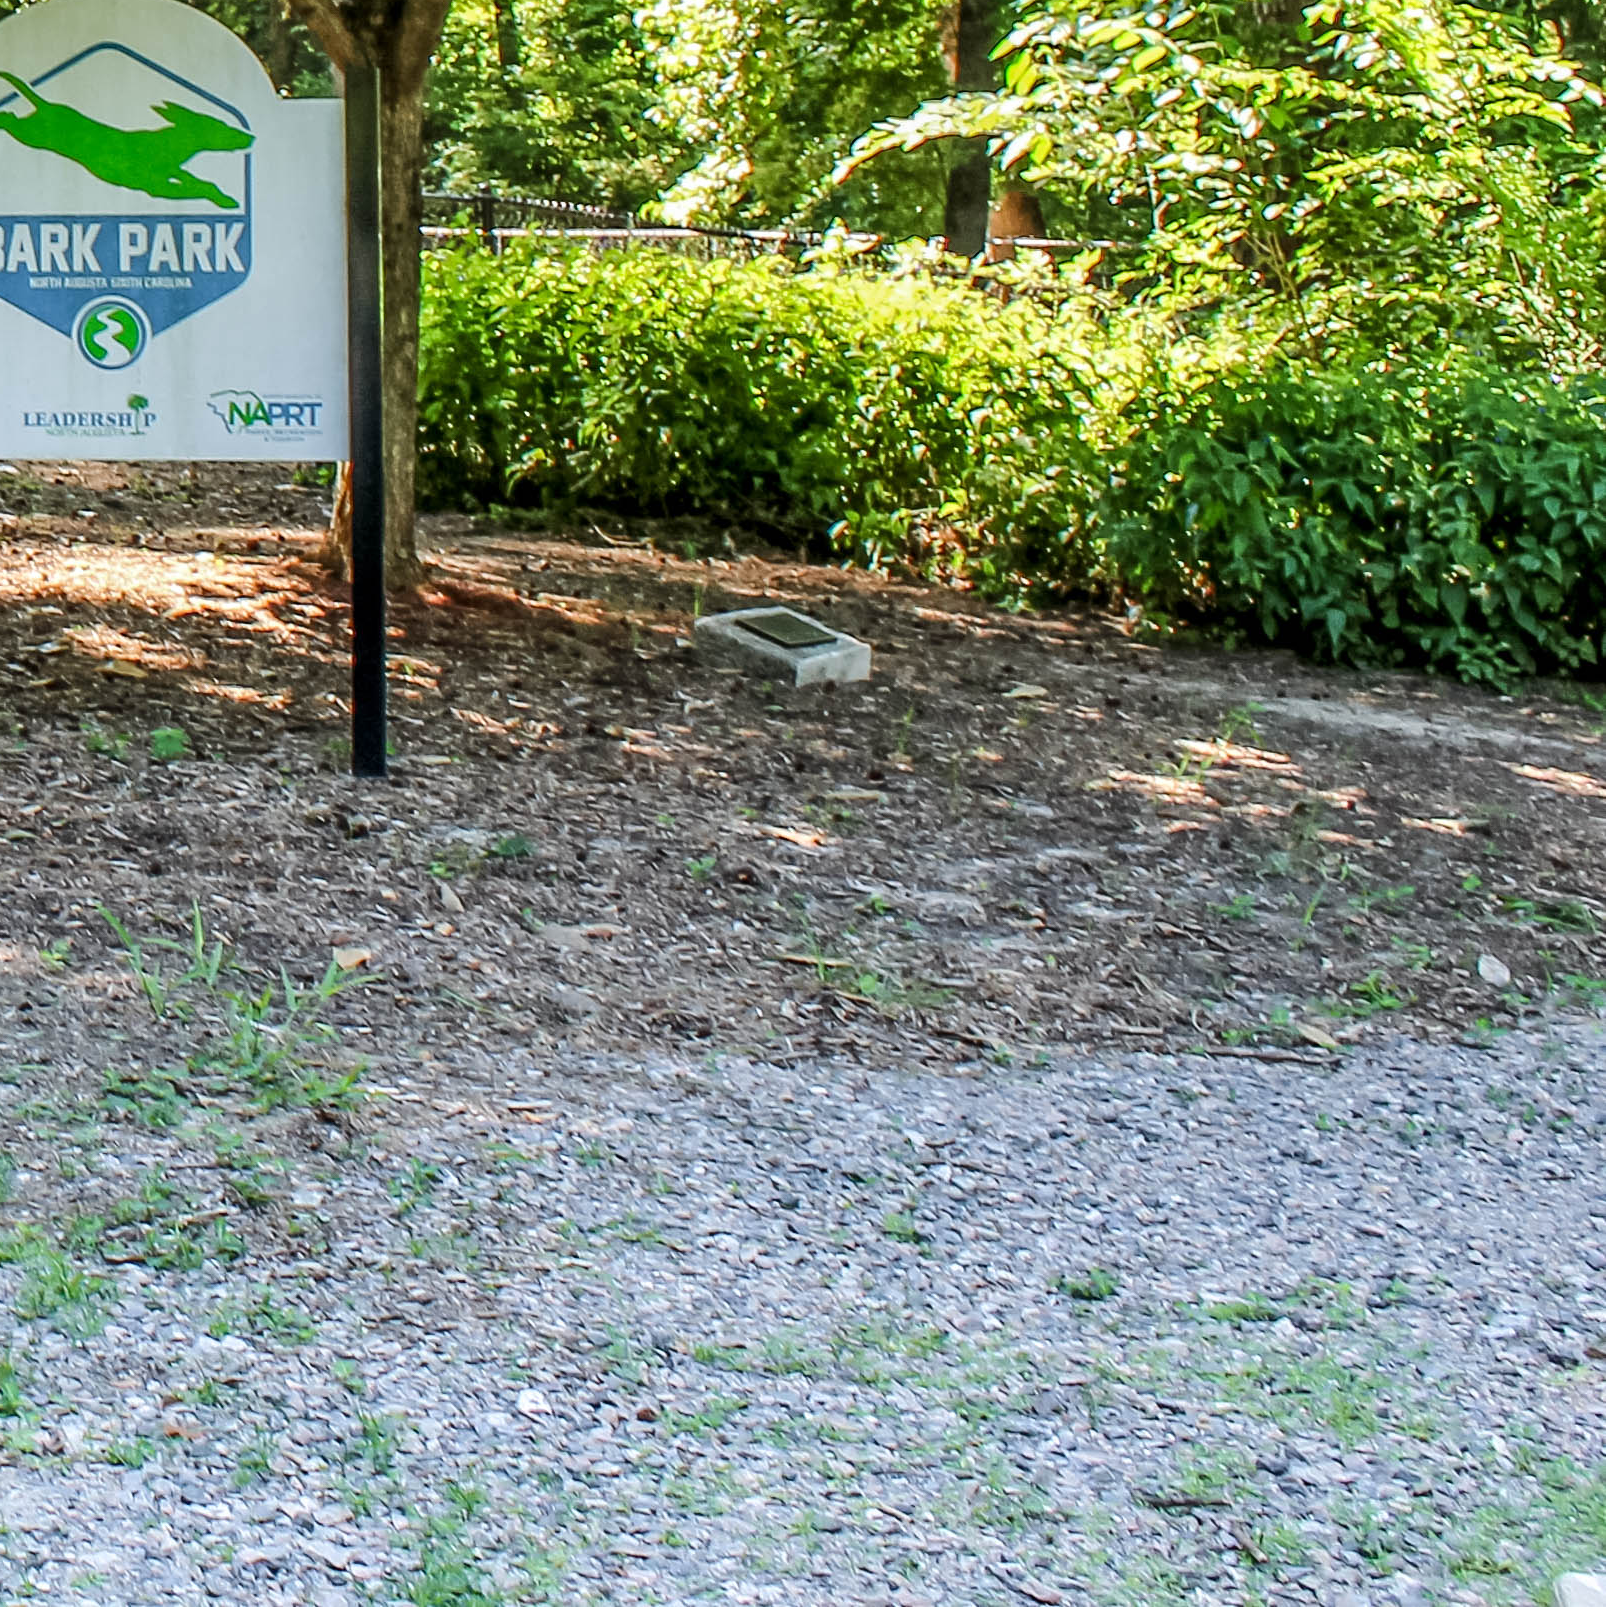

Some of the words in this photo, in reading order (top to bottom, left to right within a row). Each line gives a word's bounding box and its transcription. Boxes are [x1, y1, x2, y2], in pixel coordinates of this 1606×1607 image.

[118, 223, 246, 273] PARK
[30, 276, 62, 289] NORTH
[64, 276, 107, 289] AUGUSTA
[144, 276, 193, 289] CAROLINA
[229, 402, 323, 426] NAPRT
